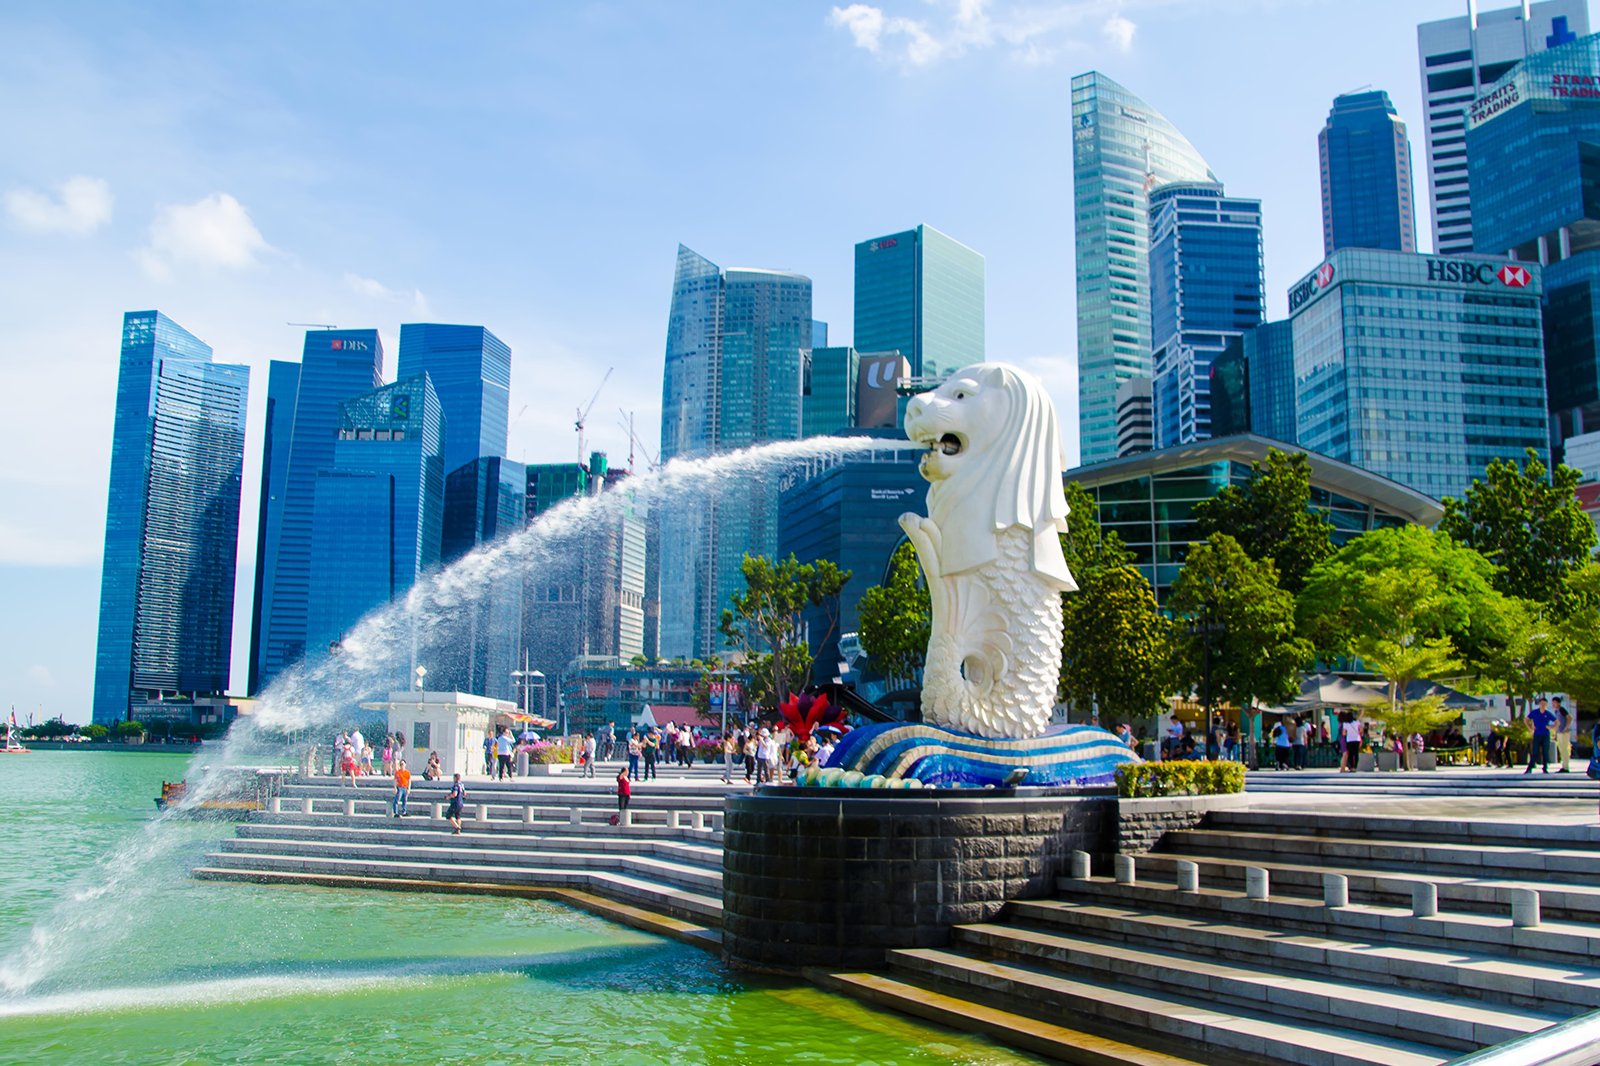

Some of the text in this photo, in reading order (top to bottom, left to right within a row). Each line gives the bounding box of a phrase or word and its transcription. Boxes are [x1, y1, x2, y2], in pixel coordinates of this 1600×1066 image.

[1471, 82, 1515, 113] STRAITS
[1471, 92, 1519, 124] TRADING
[1427, 259, 1494, 285] HSBC
[1289, 273, 1318, 313] HSBC
[343, 340, 368, 350] DBS
